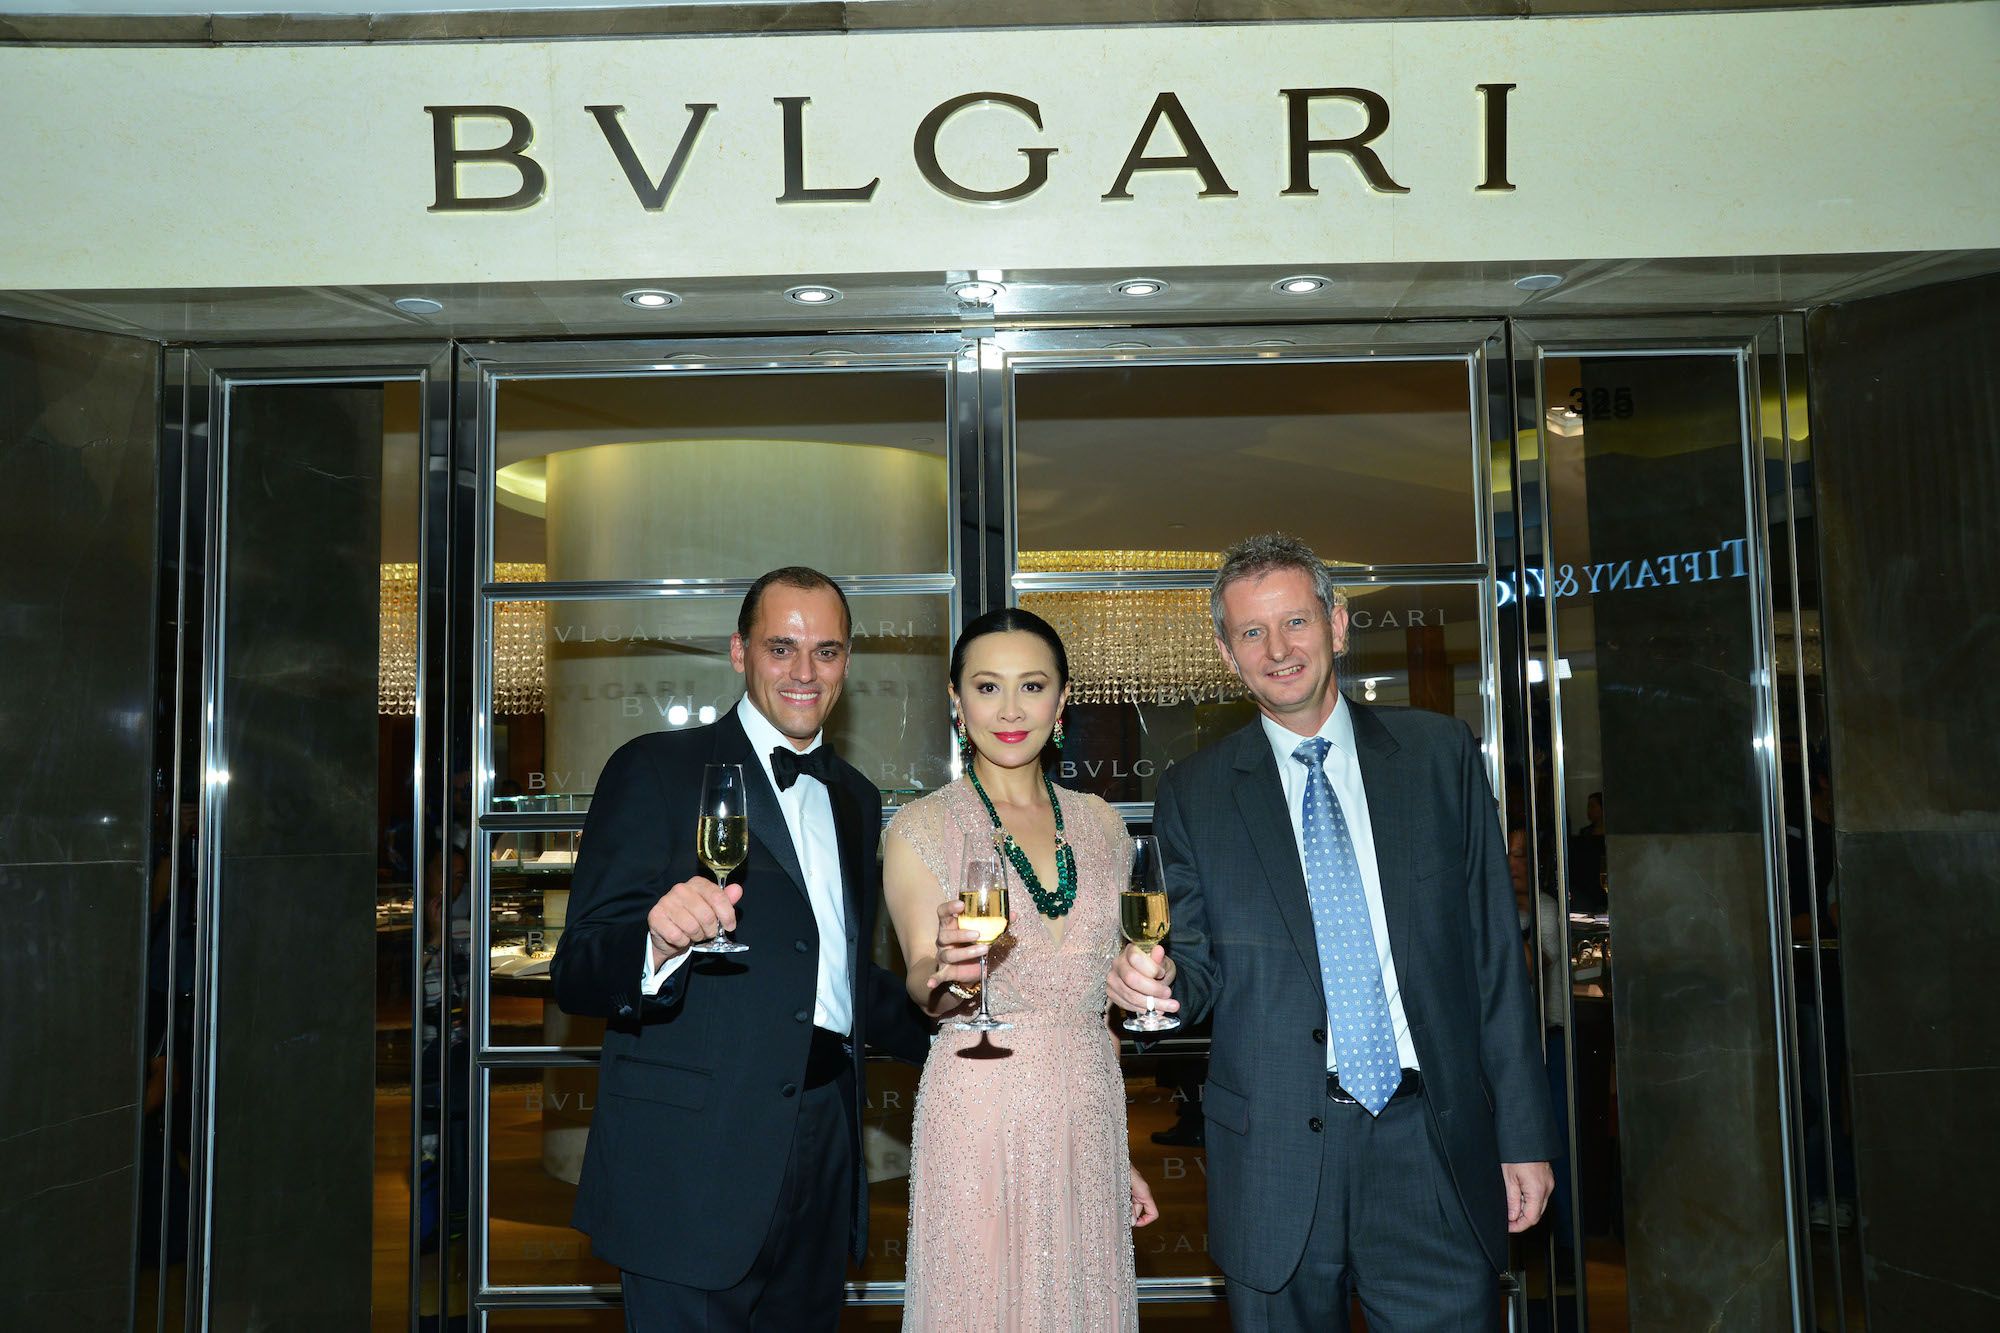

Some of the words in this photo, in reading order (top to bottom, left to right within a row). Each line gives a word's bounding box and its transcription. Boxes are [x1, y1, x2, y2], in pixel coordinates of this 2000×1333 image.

[424, 84, 1518, 212] BVLGARI
[1568, 387, 1634, 417] 325
[1351, 609, 1446, 628] GARI
[553, 622, 696, 643] VLGARI
[1060, 759, 1175, 778] BVLG
